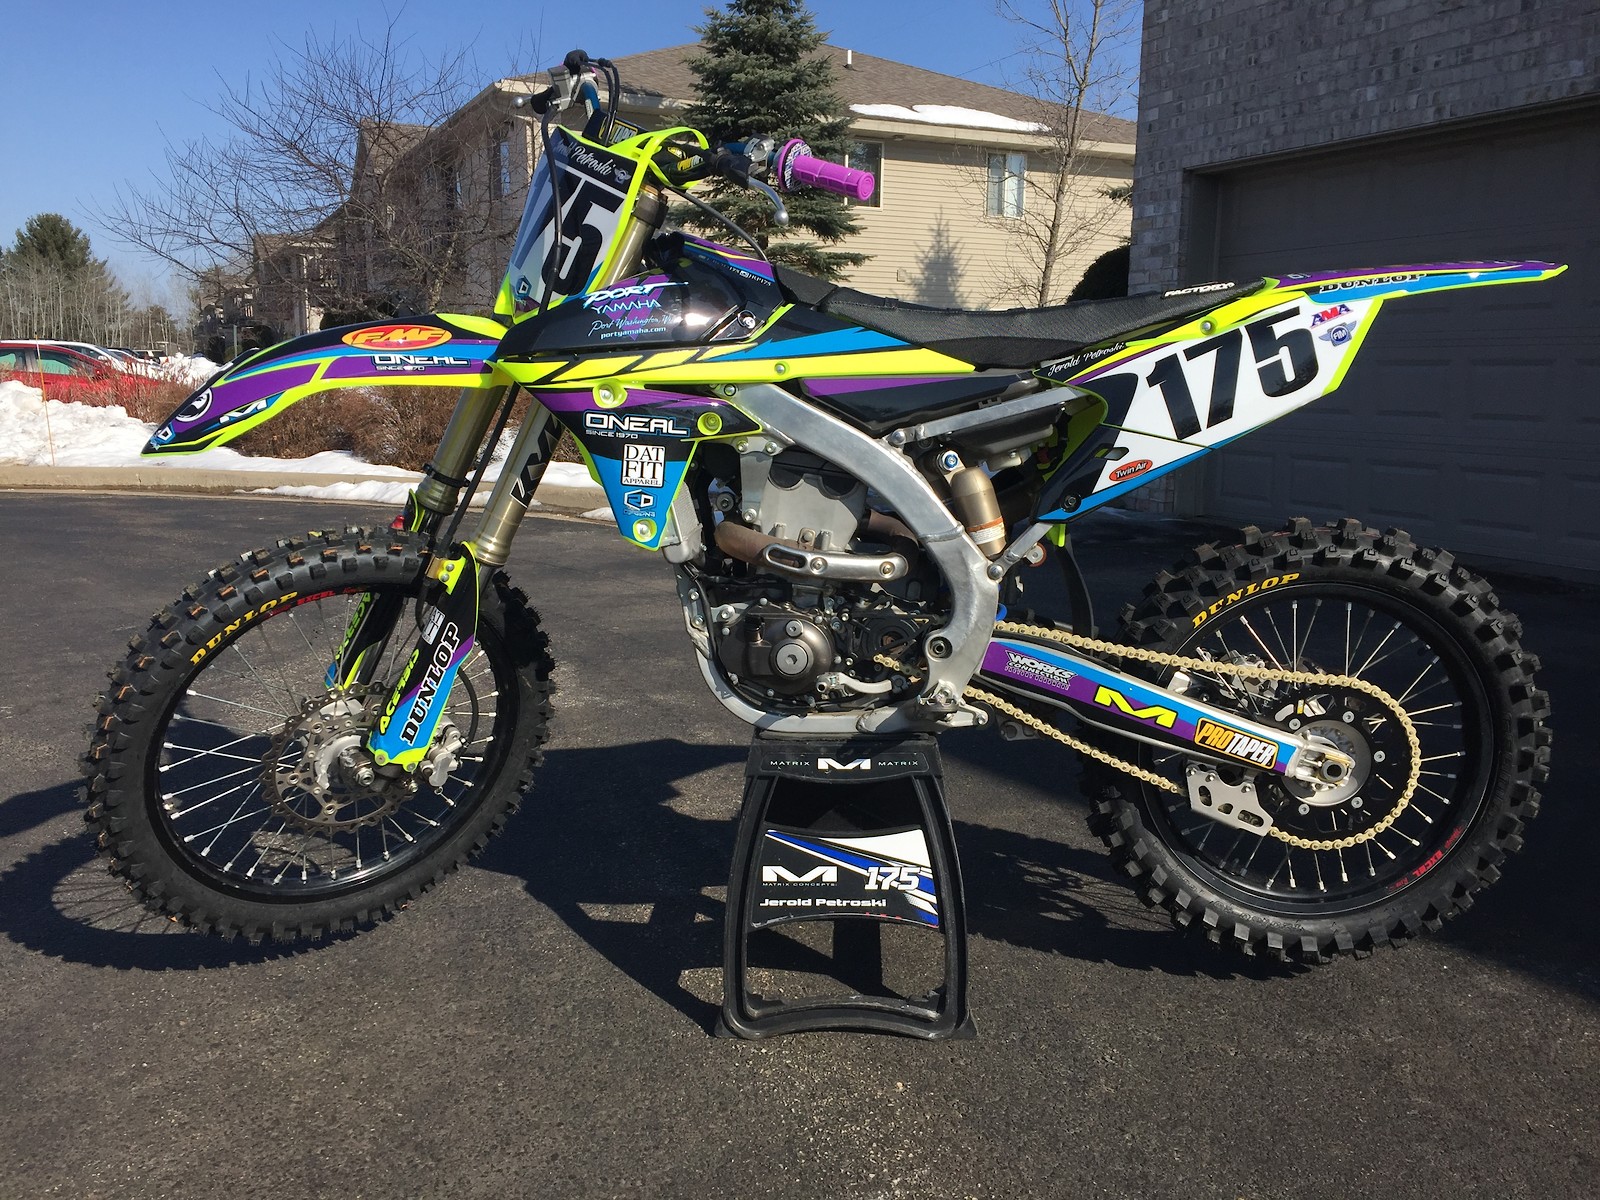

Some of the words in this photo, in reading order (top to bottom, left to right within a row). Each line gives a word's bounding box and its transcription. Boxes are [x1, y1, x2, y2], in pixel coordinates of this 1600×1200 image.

[1319, 272, 1428, 294] DUNLOP
[591, 298, 662, 315] YAMAHA
[1311, 303, 1351, 327] AMA
[351, 328, 447, 345] FMF
[600, 325, 667, 340] portyamaha.com
[1047, 355, 1081, 377] Jerold
[1145, 306, 1319, 441] 175
[585, 413, 688, 436] ONEAL
[585, 429, 615, 437] SINCE
[625, 445, 664, 461] DAT
[623, 460, 663, 480] FIT
[1115, 466, 1135, 479] Twin
[1135, 461, 1148, 471] Air
[623, 478, 662, 486] APPAREL
[1191, 572, 1301, 629] DUNLOP
[190, 591, 298, 666] DUNLOP
[1008, 661, 1068, 684] CONNECTION
[1009, 651, 1077, 679] WORKS
[400, 621, 459, 747] DUNLOP
[864, 866, 922, 890] 175
[759, 898, 813, 907] Jerold
[815, 898, 887, 907] Petroski
